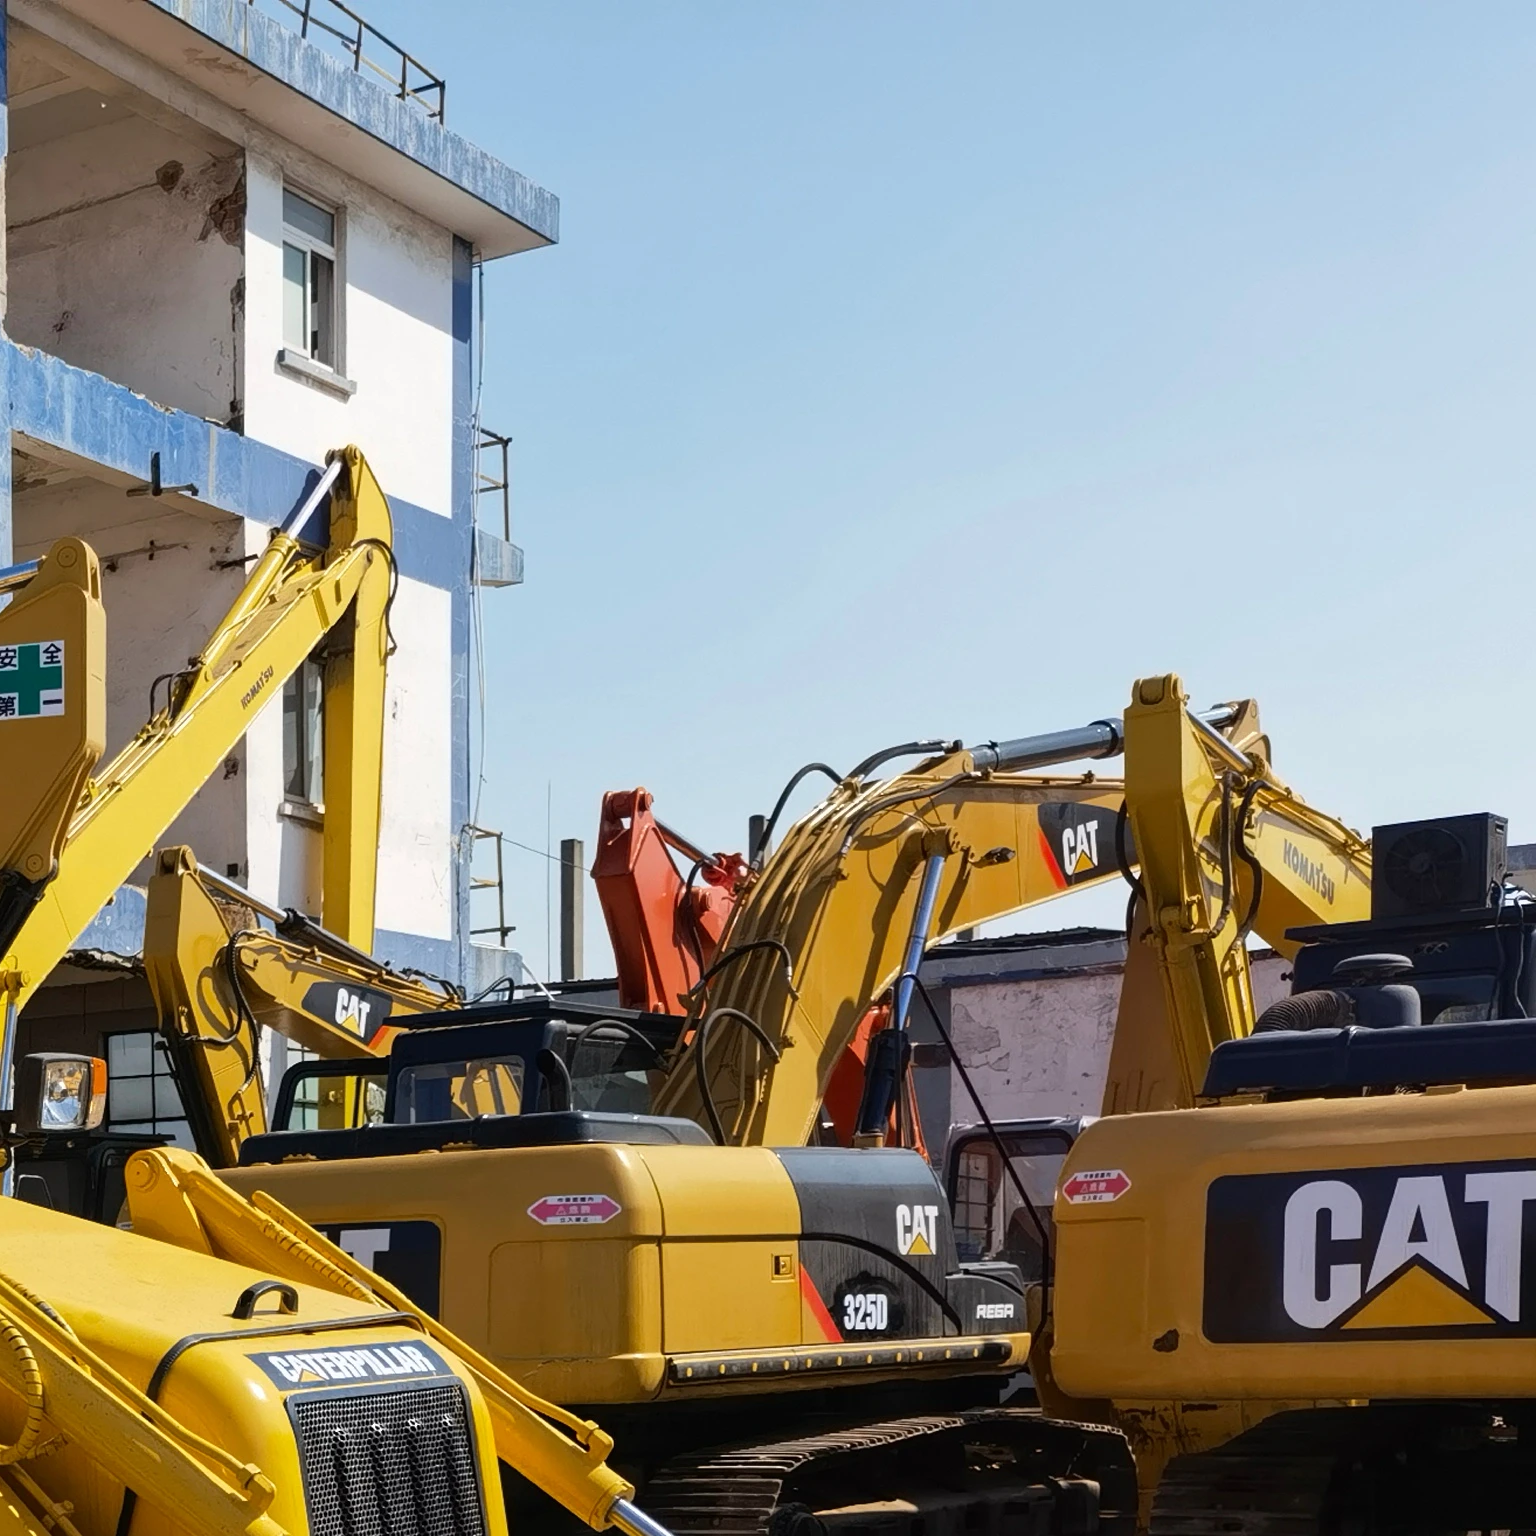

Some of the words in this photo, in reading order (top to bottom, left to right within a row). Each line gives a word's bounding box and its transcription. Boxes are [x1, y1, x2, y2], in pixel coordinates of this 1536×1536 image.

[241, 665, 274, 710] KOMATSU
[1062, 820, 1098, 876] CAT
[1283, 838, 1335, 906] KOMATSU
[335, 988, 371, 1038] CAT
[896, 1204, 939, 1255] CAT
[1283, 1170, 1536, 1329] CAT
[843, 1294, 888, 1330] 325D
[268, 1346, 436, 1382] CATERPILLAR
